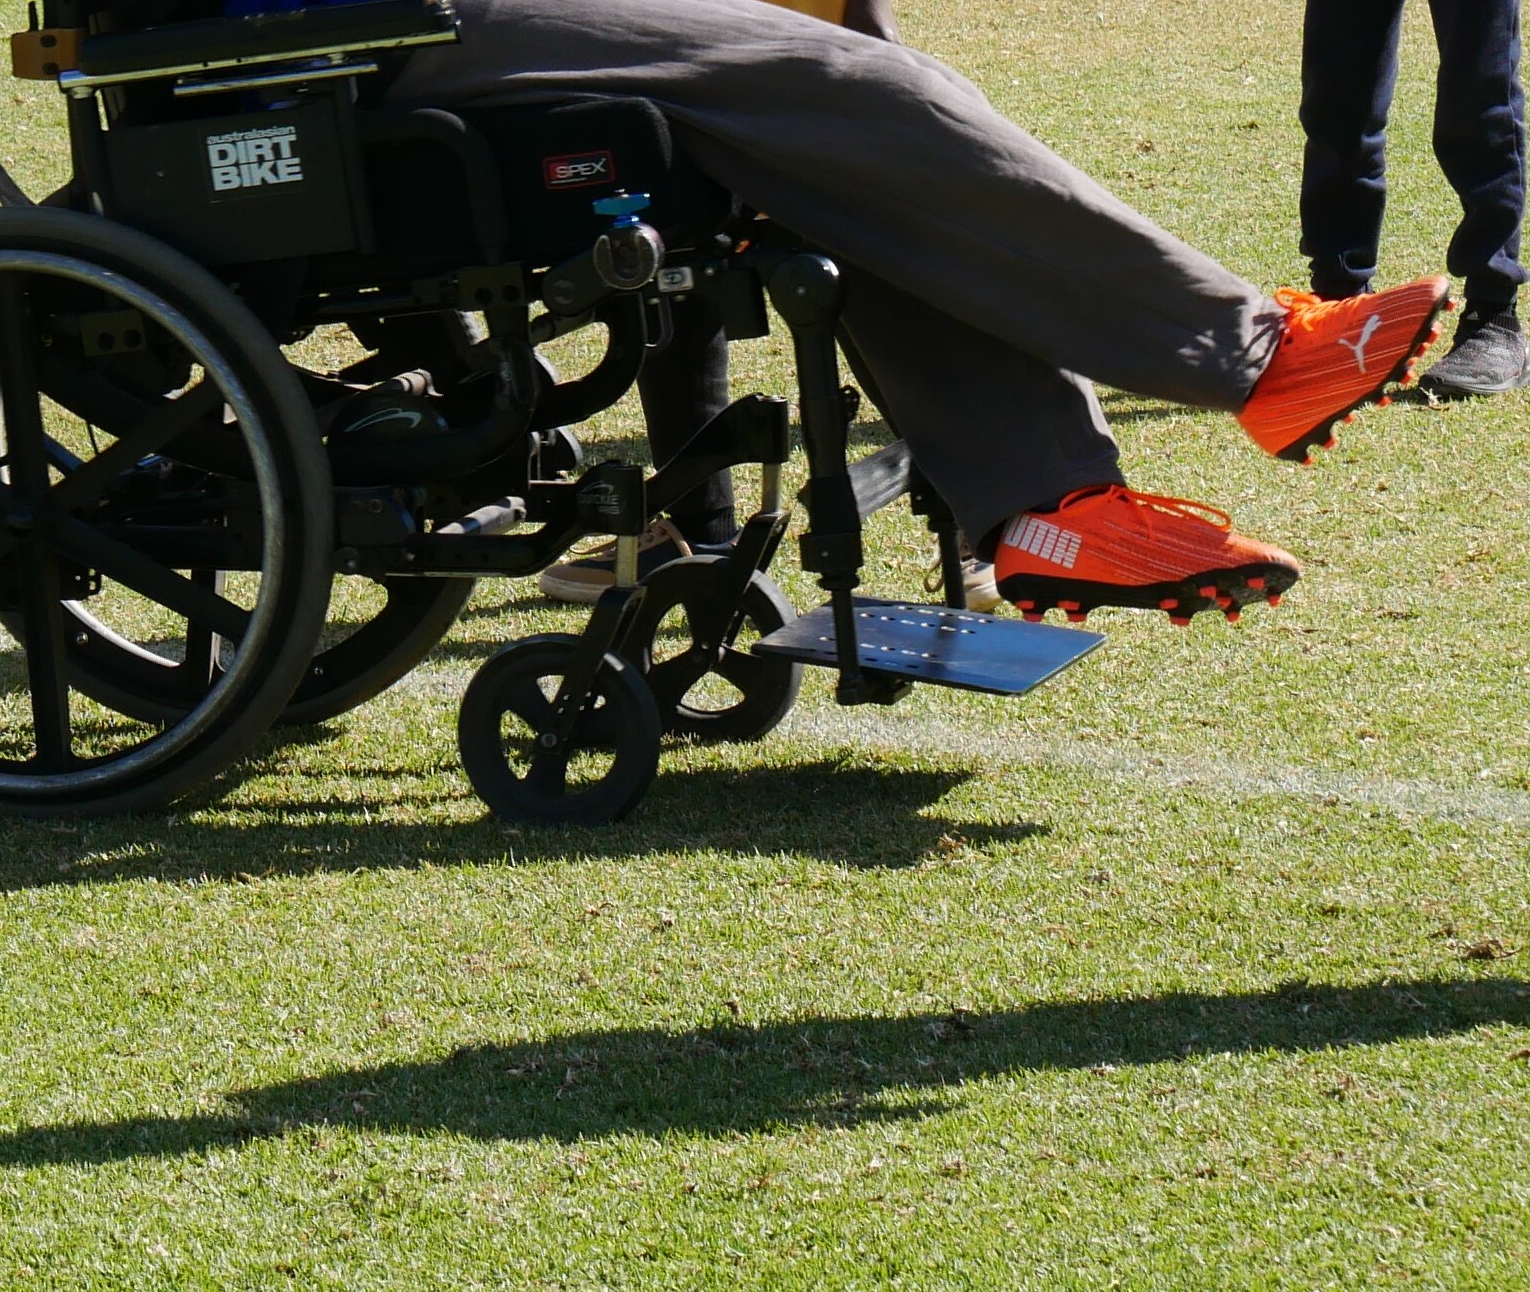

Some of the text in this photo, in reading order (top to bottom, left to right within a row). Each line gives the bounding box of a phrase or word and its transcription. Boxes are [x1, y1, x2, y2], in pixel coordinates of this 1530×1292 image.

[207, 134, 297, 168] DIRT
[556, 157, 607, 179] SPEX
[211, 157, 304, 191] BIKE
